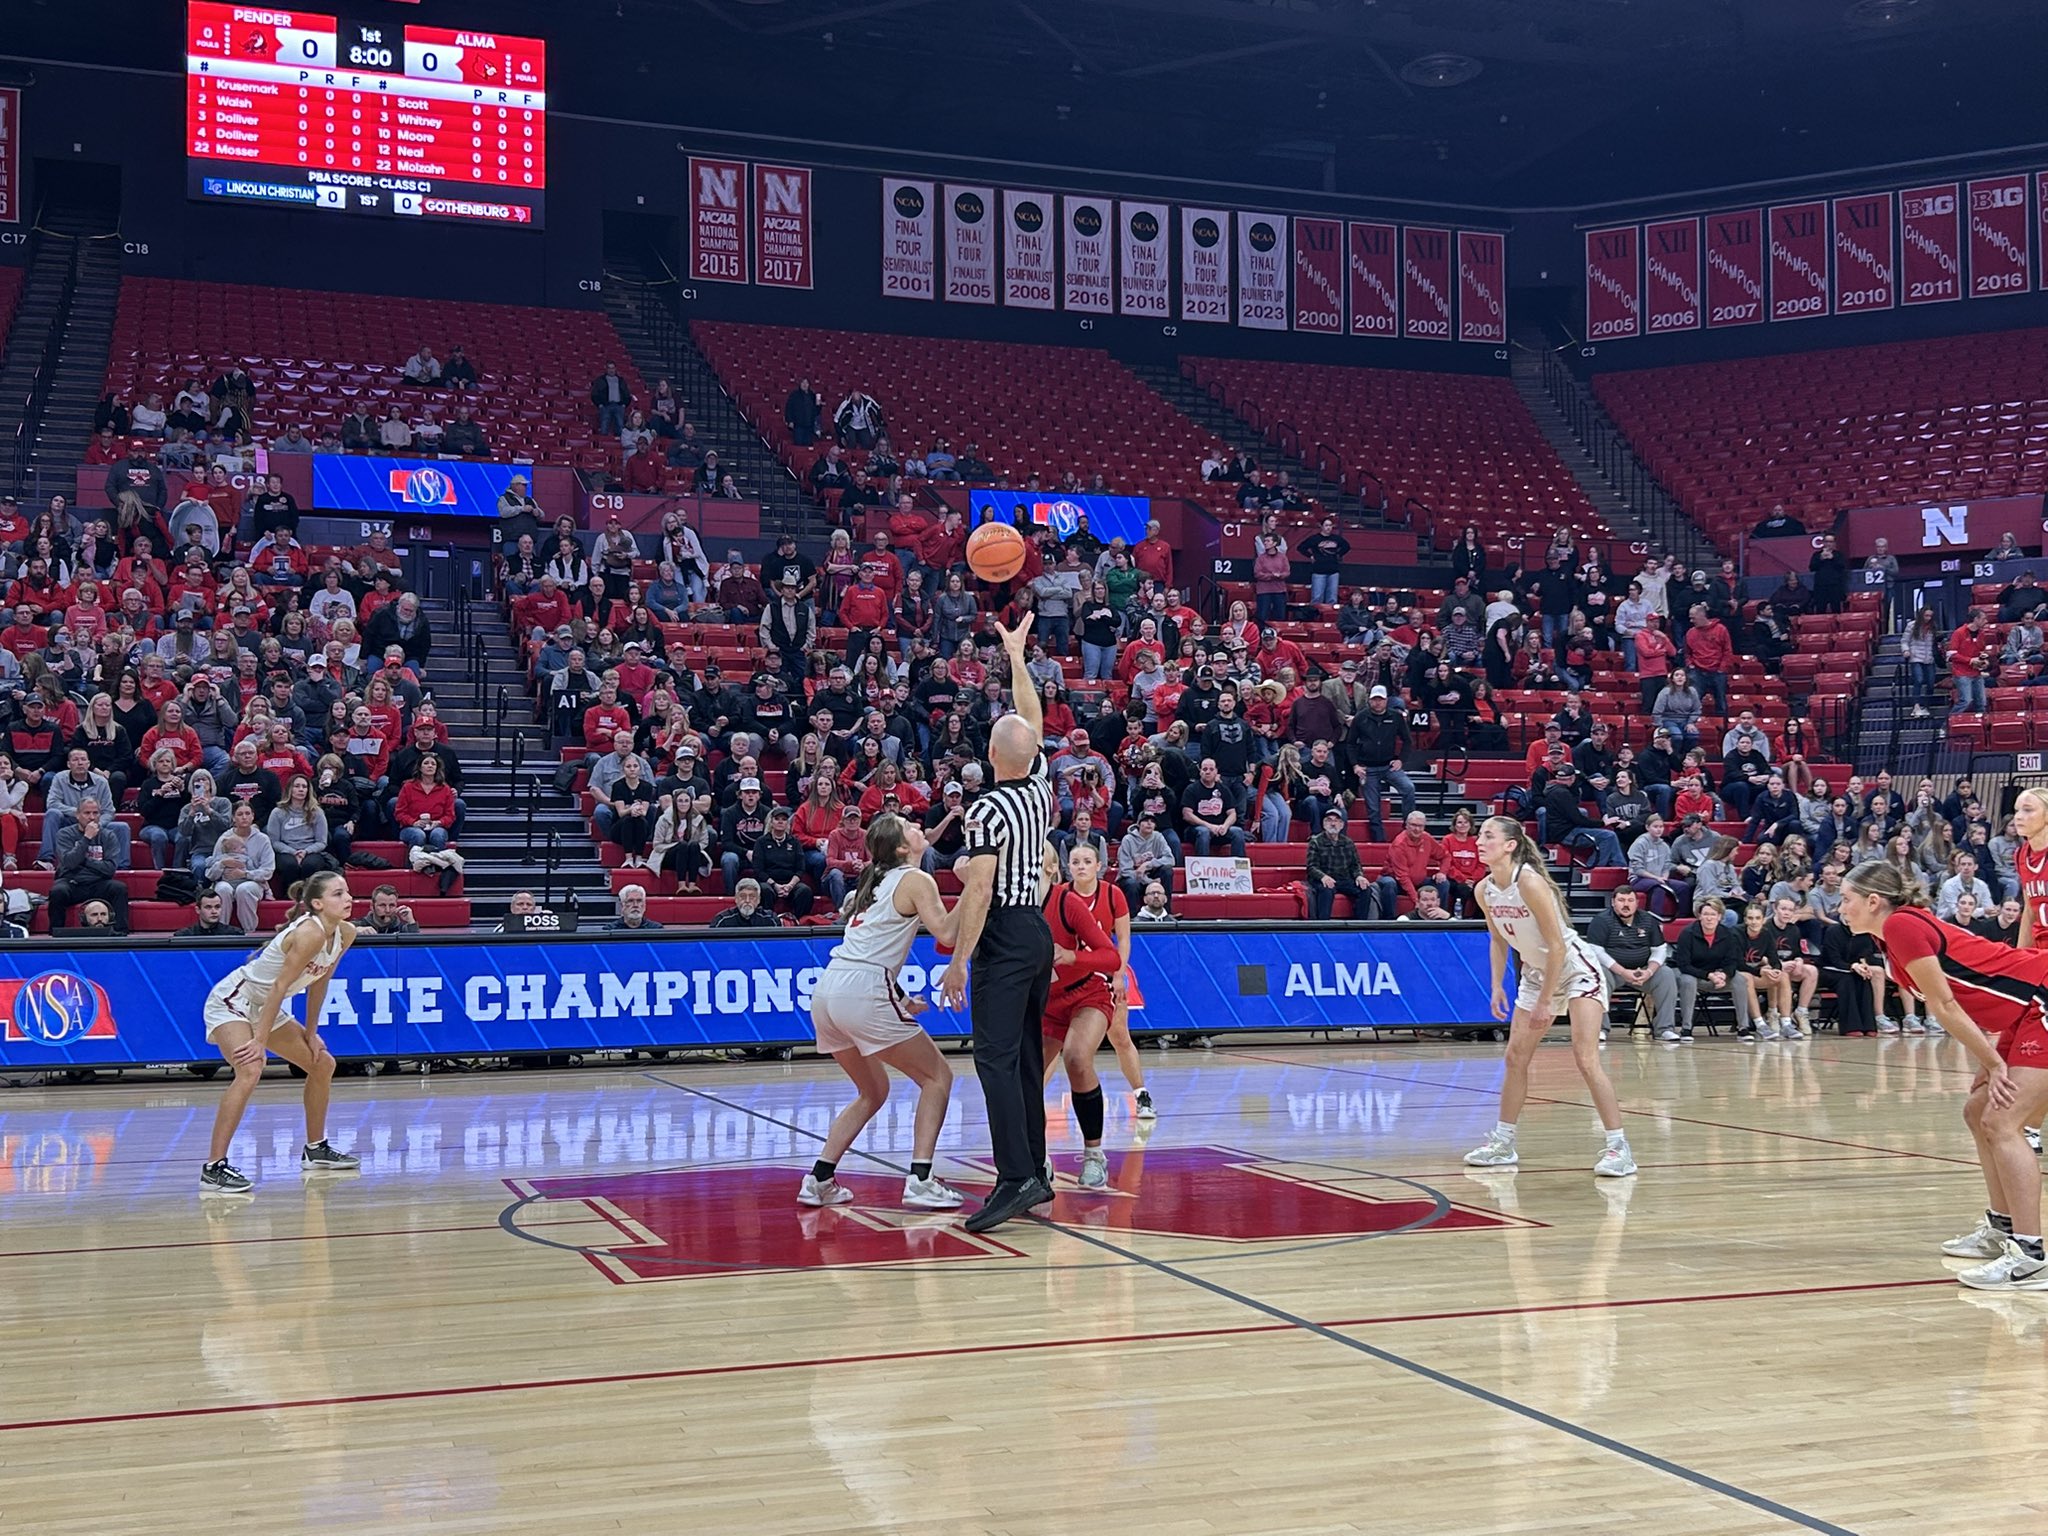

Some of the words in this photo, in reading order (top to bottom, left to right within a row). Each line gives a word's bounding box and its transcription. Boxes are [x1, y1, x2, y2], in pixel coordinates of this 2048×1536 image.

[234, 9, 291, 27] PENDER
[203, 27, 212, 38] 0
[361, 28, 381, 43] 1st
[303, 39, 318, 58] 0
[455, 33, 496, 49] ALMA
[350, 46, 392, 66] 8:00
[423, 53, 437, 71] 0
[200, 62, 208, 71] #
[300, 71, 308, 81] P
[326, 74, 334, 84] R
[353, 77, 359, 86] F
[522, 62, 530, 73] 0
[200, 78, 205, 87] 1
[216, 79, 278, 95] Krusemark
[198, 94, 206, 104] 2
[216, 96, 252, 108] Walsh
[382, 96, 387, 106] 1
[398, 98, 429, 110] Scott
[474, 89, 482, 99] P
[499, 92, 506, 102] R
[524, 95, 531, 104] F
[198, 111, 206, 121] 3
[216, 112, 259, 125] Dolliver
[380, 112, 388, 122] 3
[398, 114, 442, 129] Whitney
[198, 127, 206, 137] 4
[216, 128, 259, 141] Dolliver
[378, 128, 390, 139] 10
[398, 130, 434, 143] Moore
[194, 142, 209, 153] 22
[216, 144, 259, 157] Mosser
[378, 144, 390, 155] 12
[398, 146, 424, 157] Neal
[376, 160, 391, 171] 22
[309, 171, 331, 183] PBA
[332, 174, 372, 187] SCORE
[379, 179, 416, 191] CLASS
[418, 182, 430, 192] C1
[699, 166, 738, 208] N
[227, 182, 266, 195] LINCOLN
[267, 185, 314, 200] CHRISTIAN
[328, 191, 337, 203] 0
[764, 172, 802, 214] N
[360, 194, 379, 206] 1ST
[402, 198, 411, 209] 0
[896, 197, 922, 208] NCAA
[425, 200, 509, 218] GOTHENBURG
[957, 203, 981, 214] NCAA
[699, 211, 736, 225] NCAA
[764, 218, 800, 231] NCAA
[1017, 212, 1040, 223] NCAA
[1076, 215, 1099, 226] NCAA
[700, 225, 738, 239] NATIONAL
[896, 220, 922, 236] FINAL
[1133, 221, 1156, 232] NCAA
[1195, 228, 1217, 238] NCAA
[2, 233, 26, 245] C17
[765, 232, 802, 245] NATIONAL
[957, 229, 983, 244] FINAL
[1016, 234, 1042, 251] FINAL
[1251, 232, 1273, 242] NCAA
[1973, 217, 2024, 267] CHAMPION
[124, 243, 148, 254] C18
[700, 238, 738, 251] CHAMPION
[765, 244, 802, 256] CHAMPION
[896, 241, 921, 256] FOUR
[1076, 240, 1101, 256] FINAL
[1905, 225, 1956, 274] CHAMPION
[958, 247, 981, 261] FOUR
[1018, 252, 1041, 267] FOUR
[1132, 245, 1157, 261] FINAL
[1193, 250, 1218, 266] FINAL
[1837, 232, 1890, 284] CHAMPION
[700, 253, 738, 276] 2015
[764, 260, 802, 281] 2017
[884, 257, 932, 276] SEMIFINALIST
[1077, 258, 1099, 273] FOUR
[1134, 262, 1156, 277] FOUR
[1251, 256, 1275, 271] FINAL
[1773, 241, 1824, 292] CHAMPION
[954, 267, 986, 280] FINALIST
[1007, 268, 1053, 283] SEMIFINALIST
[1066, 273, 1109, 288] SEMIFINALIST
[1196, 267, 1216, 282] FOUR
[1252, 272, 1273, 287] FOUR
[1297, 250, 1340, 311] CHAMPION
[1709, 250, 1760, 299] CHAMPION
[579, 280, 601, 291] C18
[888, 276, 930, 292] 2001
[1123, 277, 1154, 291] RUNNER
[1156, 281, 1166, 292] UP
[1352, 254, 1394, 313] CHAMPION
[1407, 259, 1448, 318] CHAMPION
[1589, 264, 1637, 313] CHAMPION
[1649, 257, 1698, 306] CHAMPION
[1911, 280, 1952, 297] 2011
[1977, 273, 2022, 290] 2016
[682, 289, 697, 299] C1
[950, 283, 990, 298] 2005
[1010, 285, 1050, 300] 2008
[1184, 282, 1215, 297] RUNNER
[1218, 286, 1227, 297] UP
[1241, 288, 1272, 302] RUNNER
[1274, 290, 1284, 303] UP
[1462, 263, 1502, 319] CHAMPION
[1842, 288, 1886, 306] 2010
[1069, 290, 1109, 306] 2016
[1126, 294, 1166, 310] 2018
[1777, 297, 1822, 314] 2008
[1186, 300, 1226, 315] 2021
[1243, 305, 1284, 320] 2023
[1713, 304, 1756, 321] 2007
[1080, 320, 1093, 330] C1
[1299, 311, 1338, 327] 2000
[1355, 315, 1393, 330] 2001
[1592, 318, 1634, 335] 2005
[1652, 311, 1694, 328] 2006
[1163, 327, 1177, 336] C2
[1408, 320, 1447, 335] 2002
[1464, 323, 1500, 336] 2004
[1495, 350, 1507, 359] C2
[1582, 348, 1595, 357] C3
[592, 494, 624, 510] C18
[1223, 523, 1241, 537] C1
[1922, 506, 1968, 547] N
[1630, 542, 1648, 554] C2
[1215, 560, 1232, 573] B2
[1974, 564, 1994, 577] B3
[1865, 571, 1885, 584] B2
[558, 695, 577, 708] A1
[1412, 713, 1428, 725] A2
[2020, 756, 2039, 768] EXIT
[1198, 877, 1231, 890] Three
[2025, 880, 2048, 897] ALM
[524, 915, 559, 926] POSS
[1285, 962, 1400, 997] ALMA
